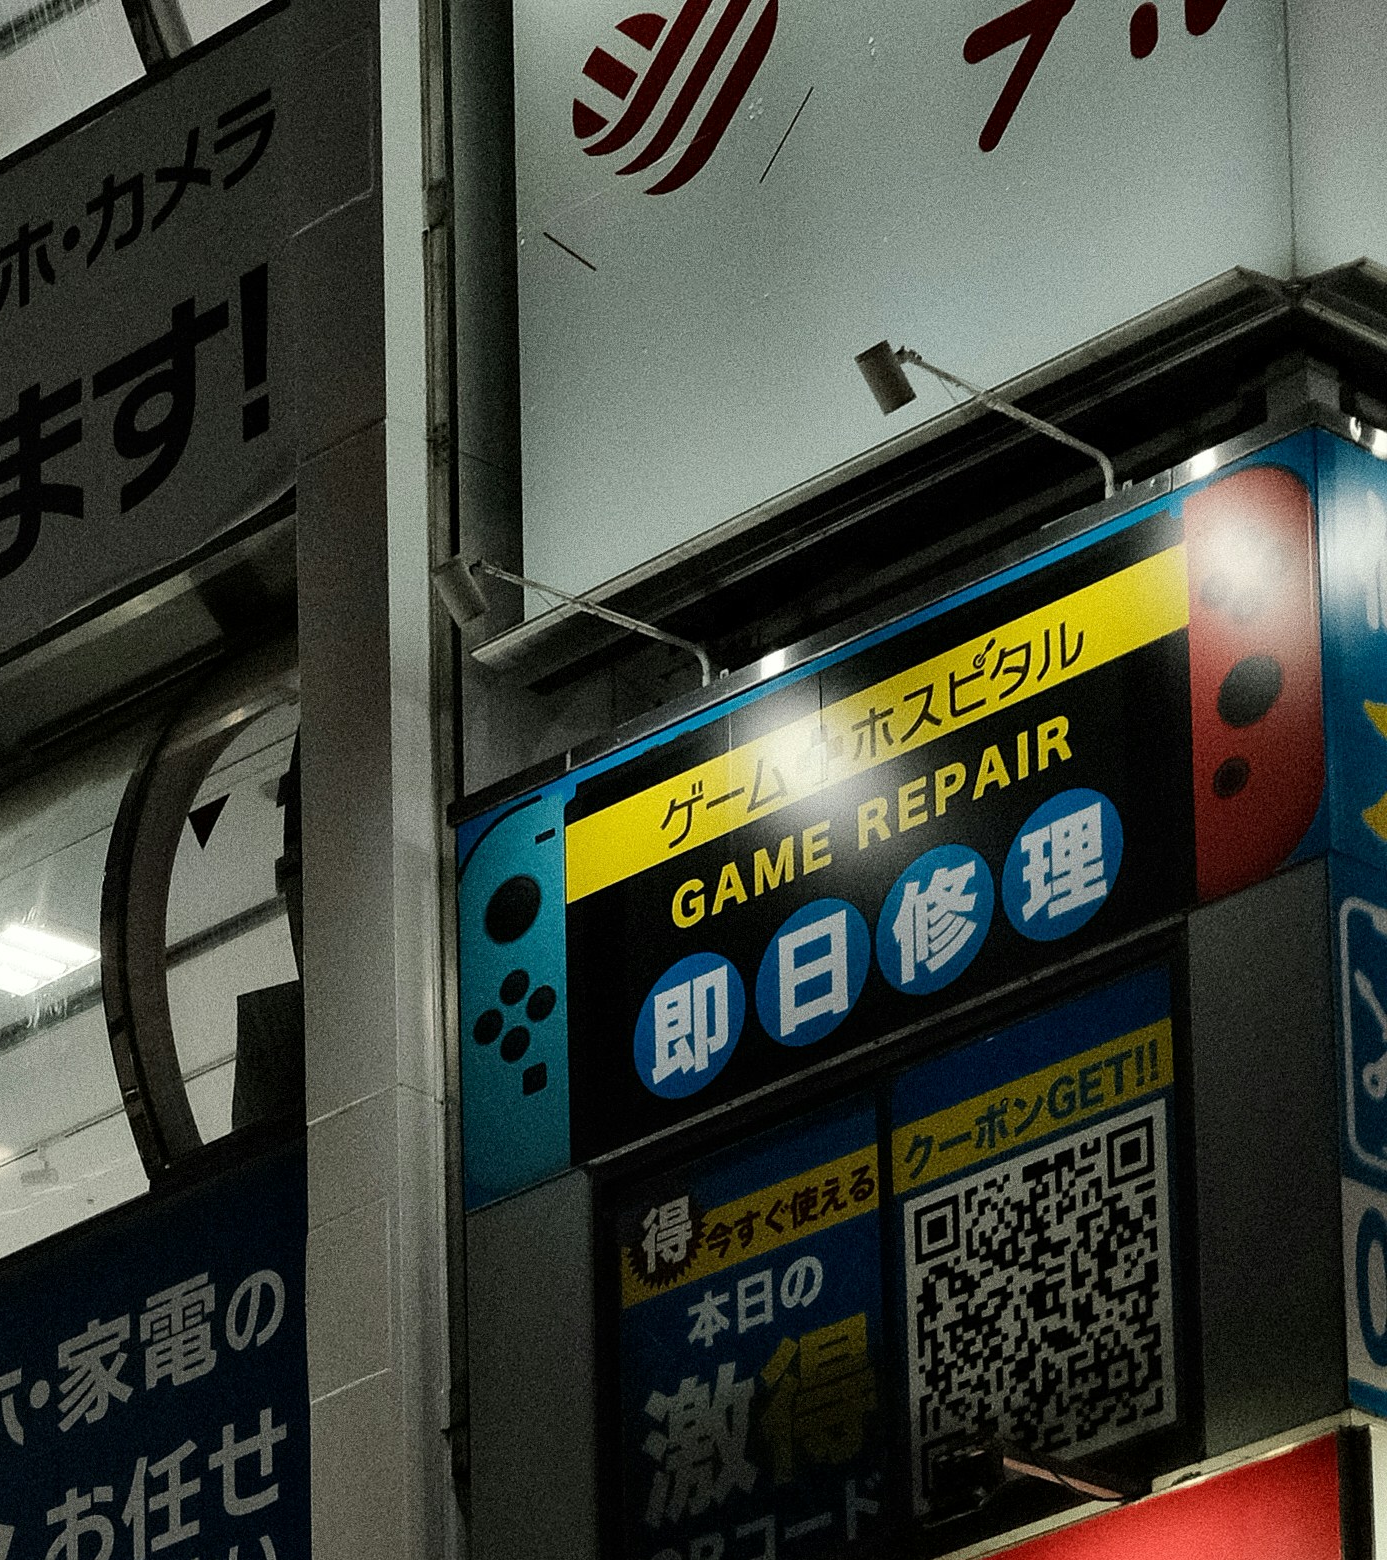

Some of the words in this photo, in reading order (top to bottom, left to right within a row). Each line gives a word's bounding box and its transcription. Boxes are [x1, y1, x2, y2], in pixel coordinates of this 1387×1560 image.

[671, 821, 832, 929] GAME
[857, 715, 1073, 851] REPAIR
[651, 801, 1108, 1085] 即日修理
[642, 1196, 692, 1274] 得
[705, 1163, 877, 1258] 今すぐ使える
[686, 1255, 824, 1347] 本日の
